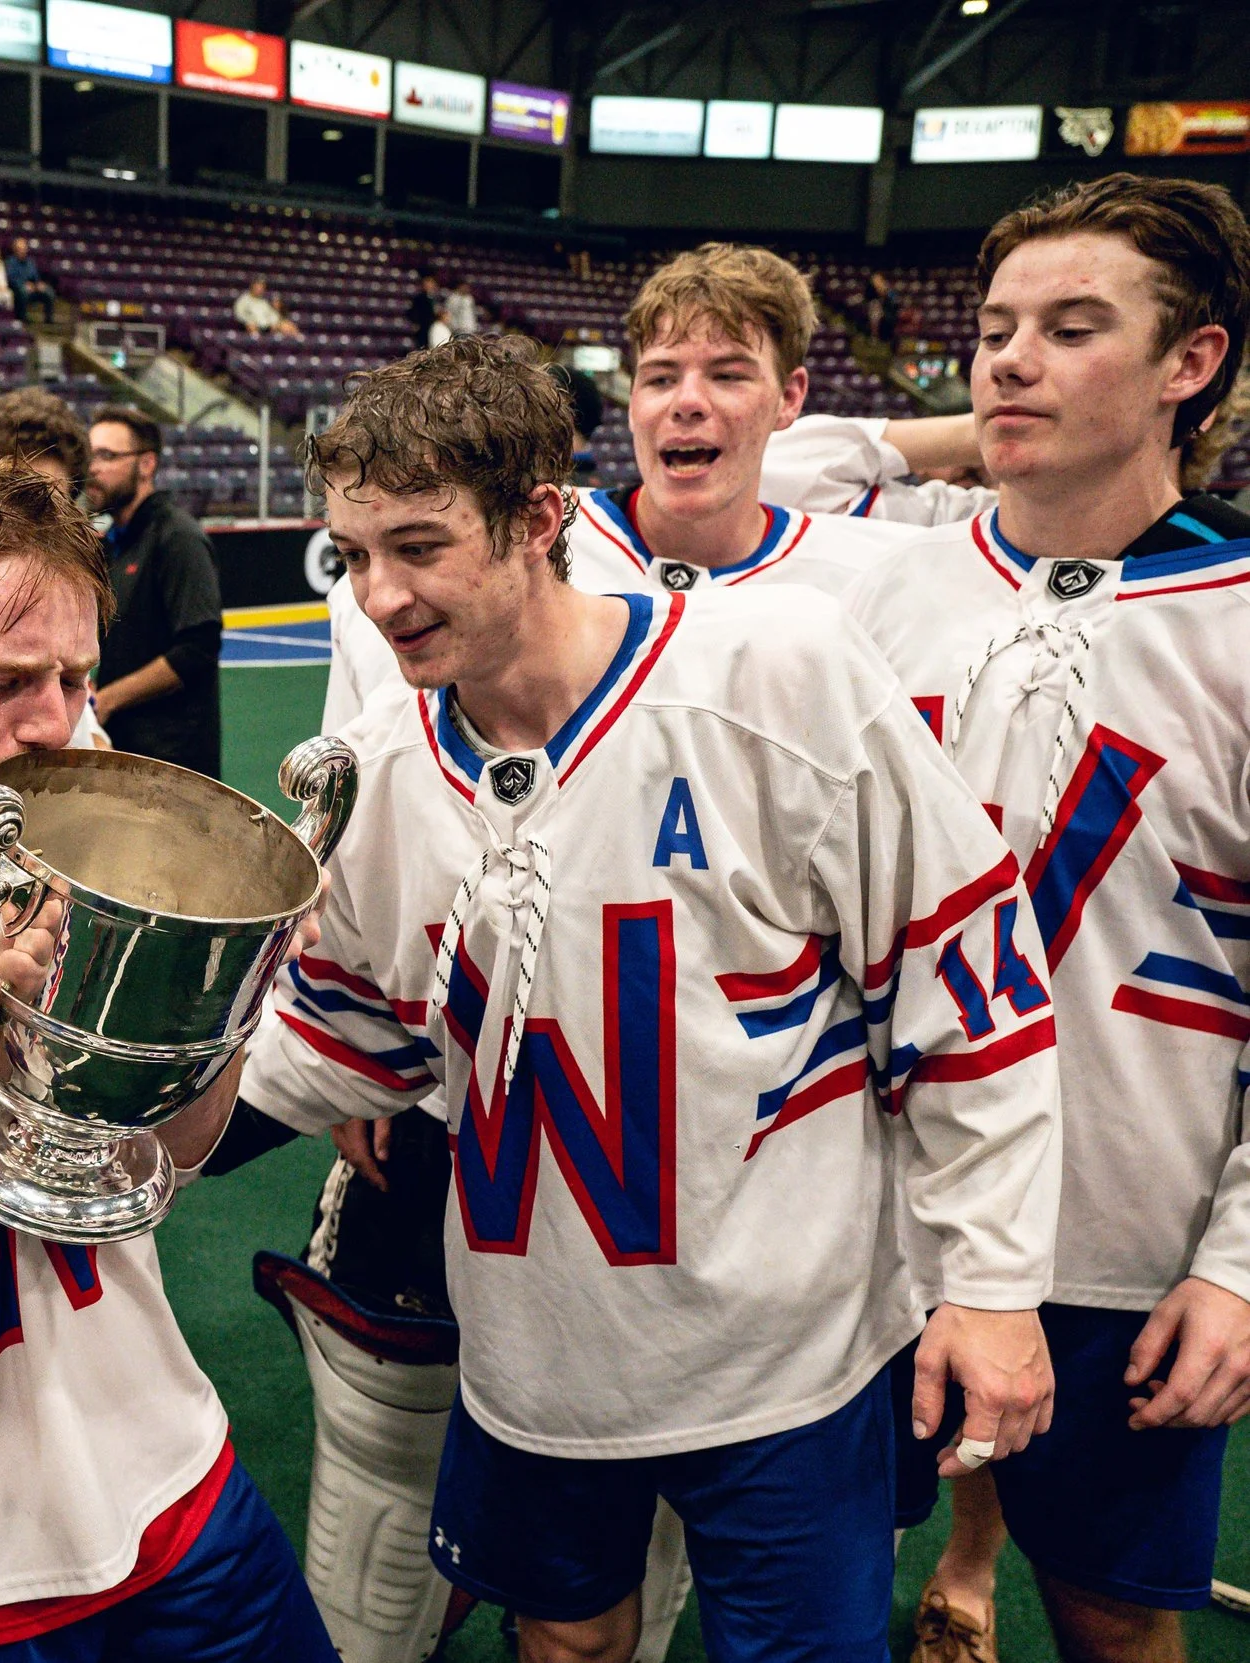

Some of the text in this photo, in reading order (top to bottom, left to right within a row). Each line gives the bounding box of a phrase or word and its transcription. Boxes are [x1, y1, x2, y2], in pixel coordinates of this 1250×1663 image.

[652, 777, 710, 870] A
[936, 897, 1052, 1041] 14
[424, 899, 677, 1267] W
